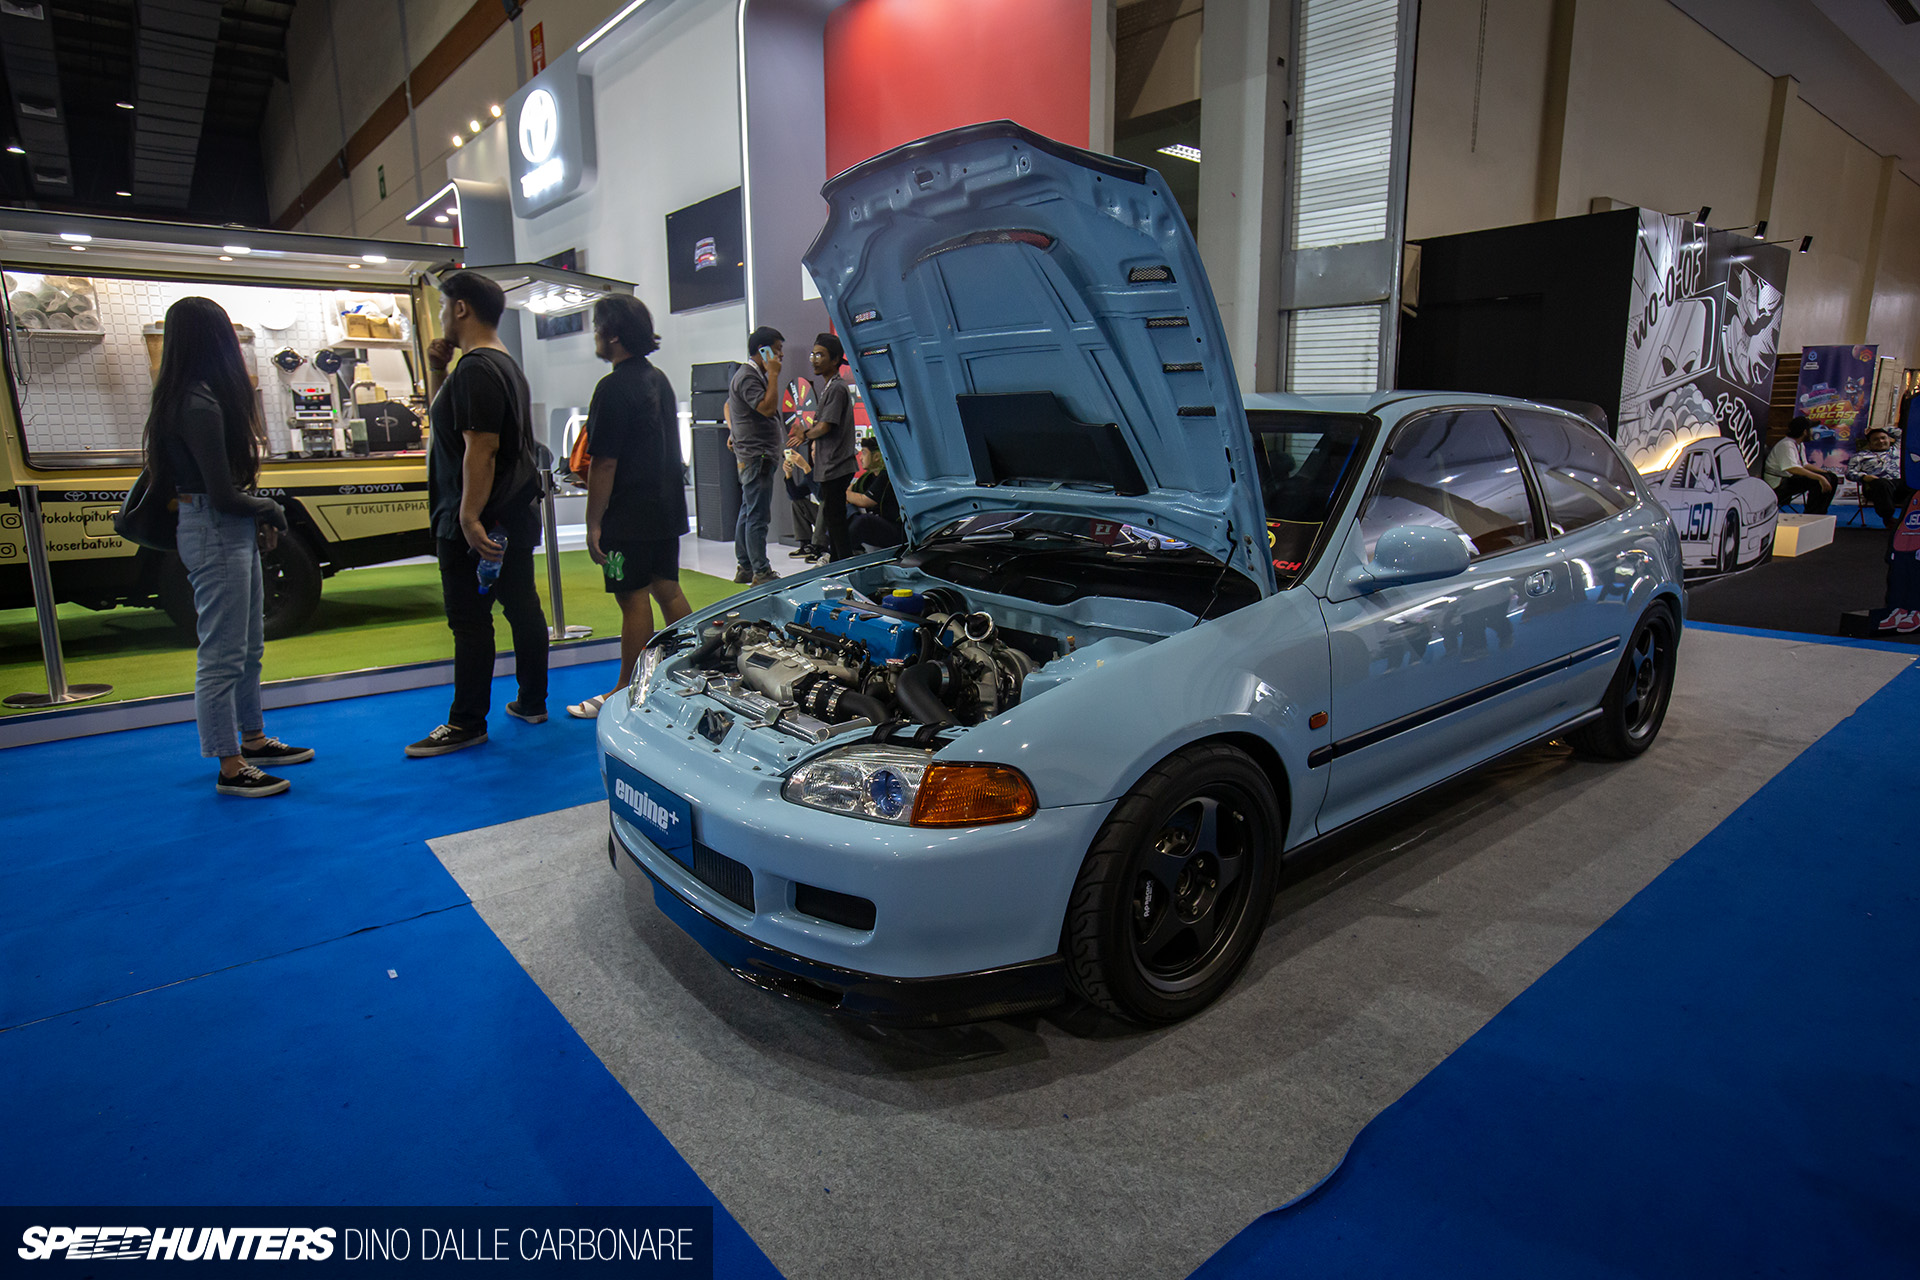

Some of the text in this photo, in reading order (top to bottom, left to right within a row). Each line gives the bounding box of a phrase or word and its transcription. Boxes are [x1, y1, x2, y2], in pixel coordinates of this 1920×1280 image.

[1809, 402, 1846, 414] TOYS
[1808, 410, 1860, 420] DIECAST
[358, 483, 404, 493] TOYOTA
[89, 491, 128, 501] TOYO
[42, 510, 113, 526] tokokopituk
[1681, 502, 1713, 541] JSD
[615, 778, 680, 830] engine+
